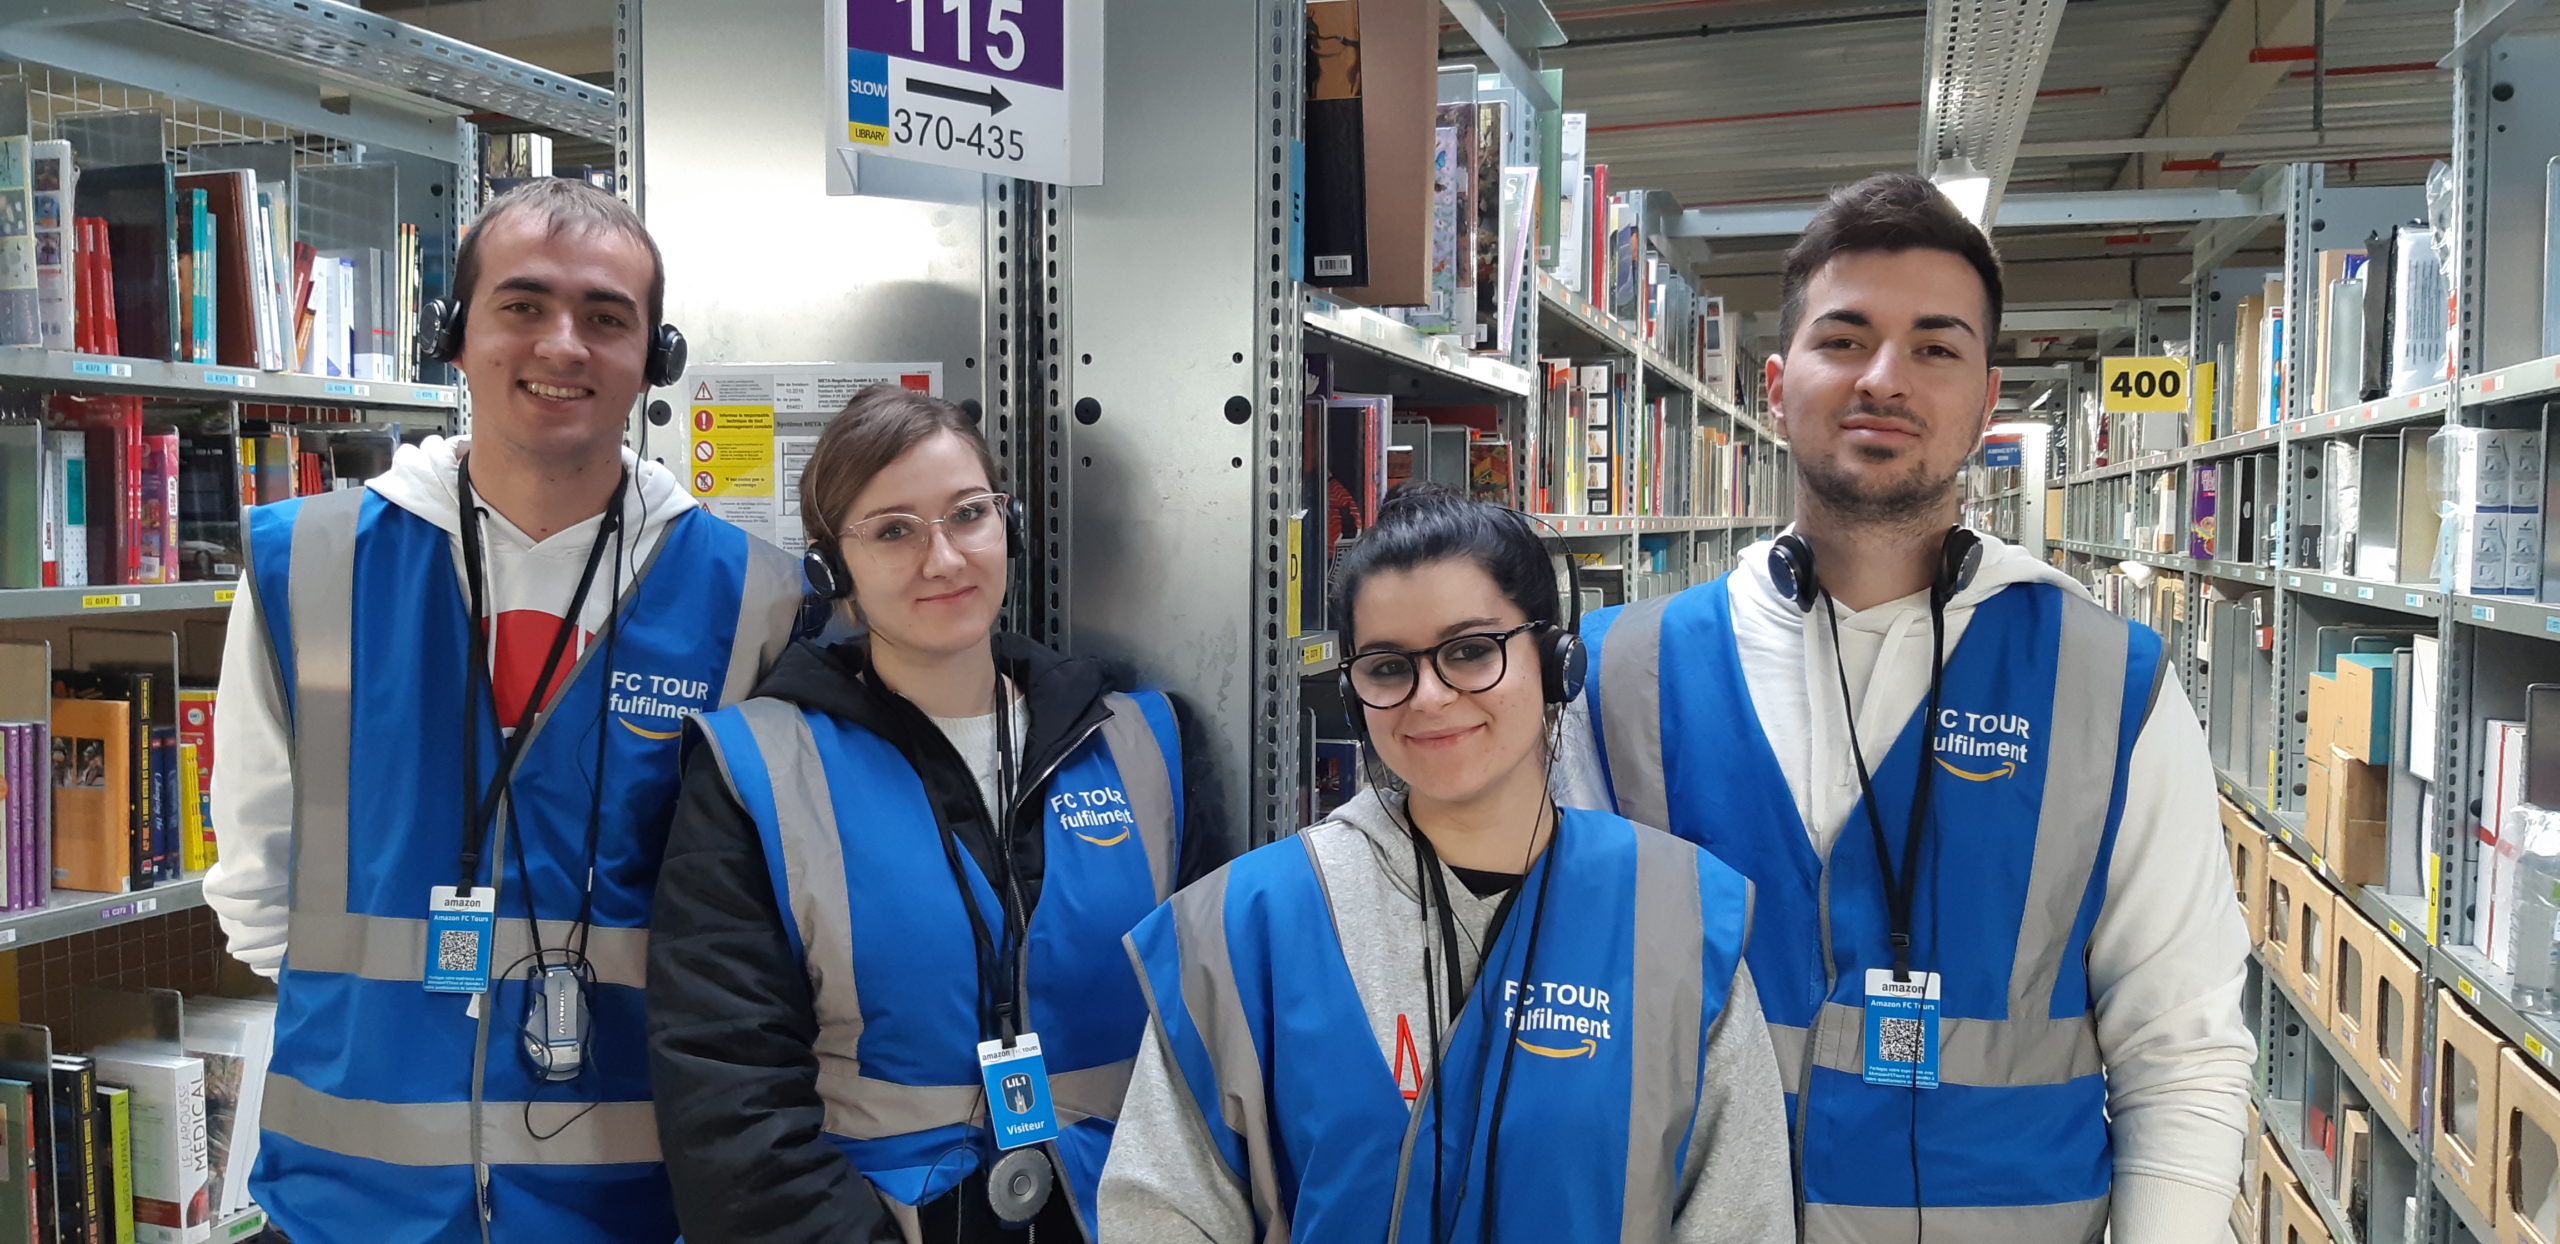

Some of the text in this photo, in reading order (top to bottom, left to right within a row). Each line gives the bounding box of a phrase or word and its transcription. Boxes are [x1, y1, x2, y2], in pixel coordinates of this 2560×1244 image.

[896, 0, 1026, 72] 115
[850, 78, 887, 98] SLOW
[855, 128, 885, 142] LIBRARY
[894, 108, 1024, 162] 370-435
[2110, 370, 2181, 398] 400
[1290, 553, 1298, 582] D
[610, 671, 709, 701] FC TOUR
[610, 693, 702, 720] fulfilmen
[1965, 712, 2030, 740] TOUR
[1933, 732, 2028, 763] ulfilment
[1050, 787, 1126, 813] FC TOUR
[444, 898, 481, 908] amazon
[1504, 979, 1611, 1014] FC TOUR
[1881, 983, 1925, 994] amazon
[1870, 999, 1935, 1010] Amazon FC Turs
[1504, 1006, 1611, 1039] fulfilment
[982, 1049, 1011, 1061] amazon
[1022, 1045, 1038, 1053] TOURS
[1005, 1076, 1027, 1088] LIL1
[190, 1070, 207, 1172] MÉDICAL
[1006, 1120, 1045, 1135] Visiteur
[181, 1153, 193, 1168] LE
